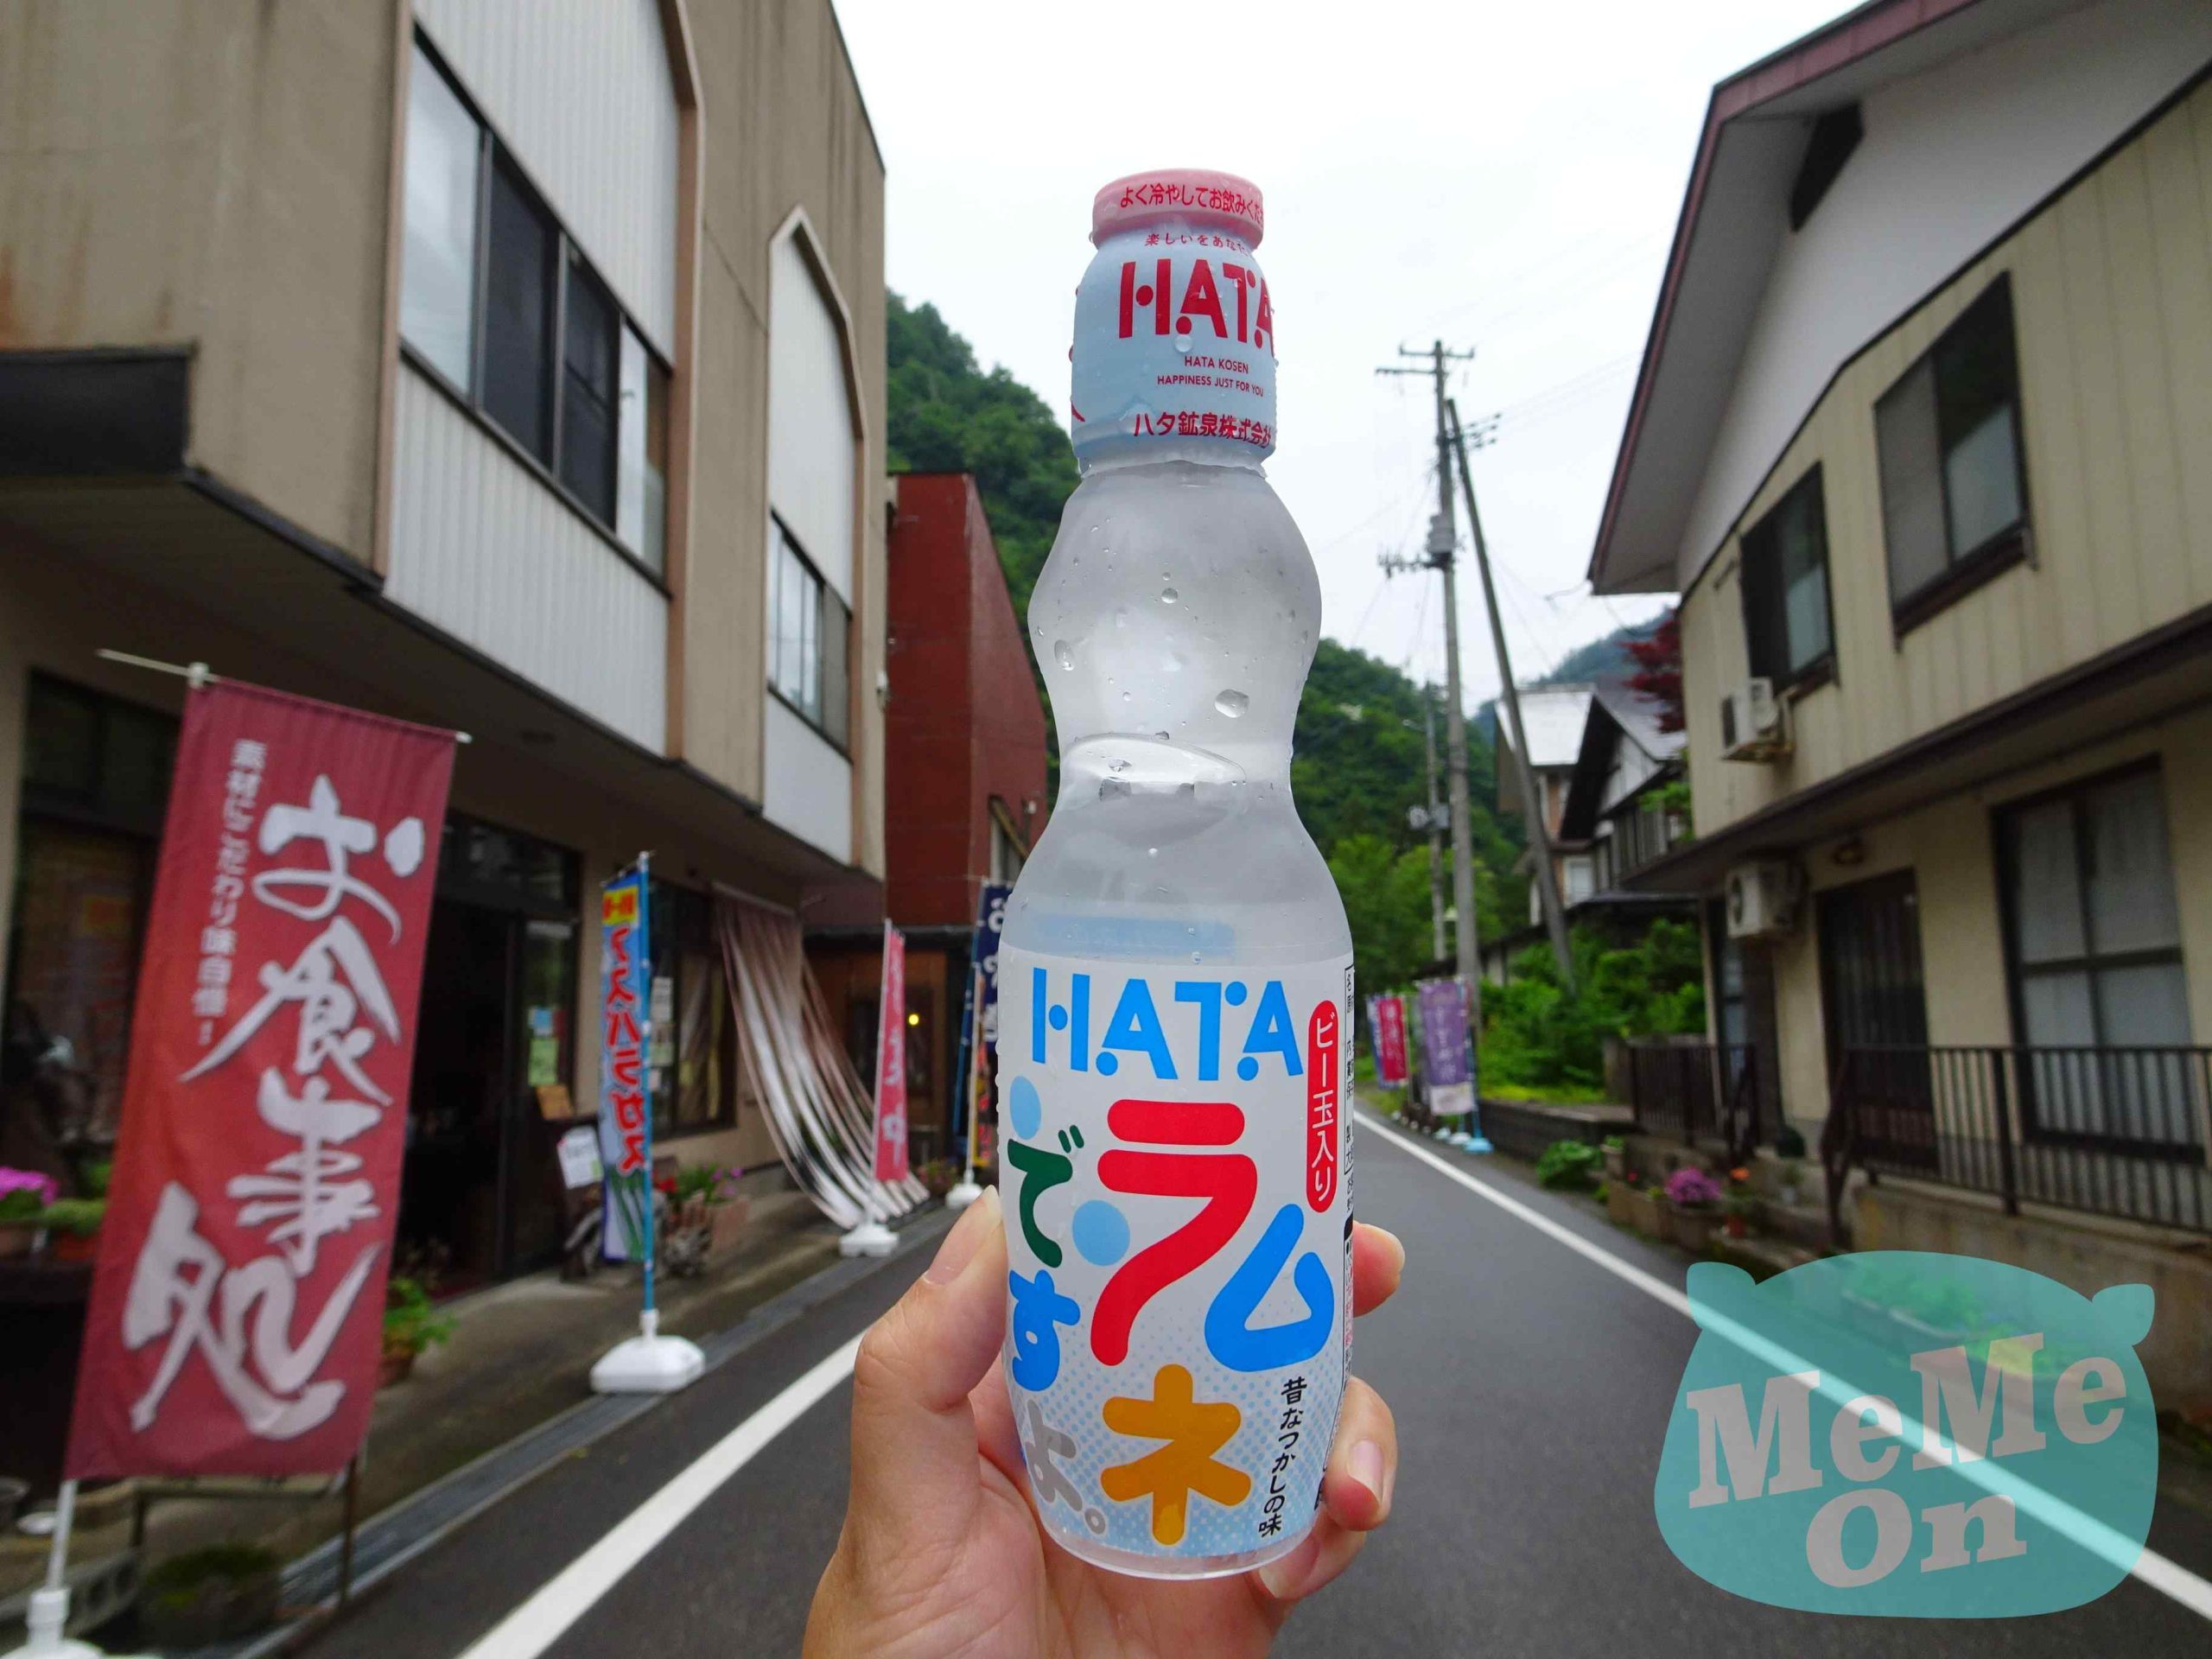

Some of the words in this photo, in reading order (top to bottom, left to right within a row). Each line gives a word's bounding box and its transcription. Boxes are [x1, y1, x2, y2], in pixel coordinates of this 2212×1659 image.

[1119, 257, 1274, 357] HATA
[1184, 356, 1215, 368] HATA
[1218, 359, 1249, 374] KOSEN
[1157, 375, 1211, 386] HAPPINESS
[1214, 378, 1234, 388] JUST
[1236, 380, 1249, 392] FOR
[1251, 384, 1264, 397] YOU
[1033, 966, 1304, 1082] HATA
[122, 774, 426, 1440] お食事処
[1311, 1010, 1336, 1203] ビー玉入り
[1258, 1376, 1307, 1538] 昔なつかしの味
